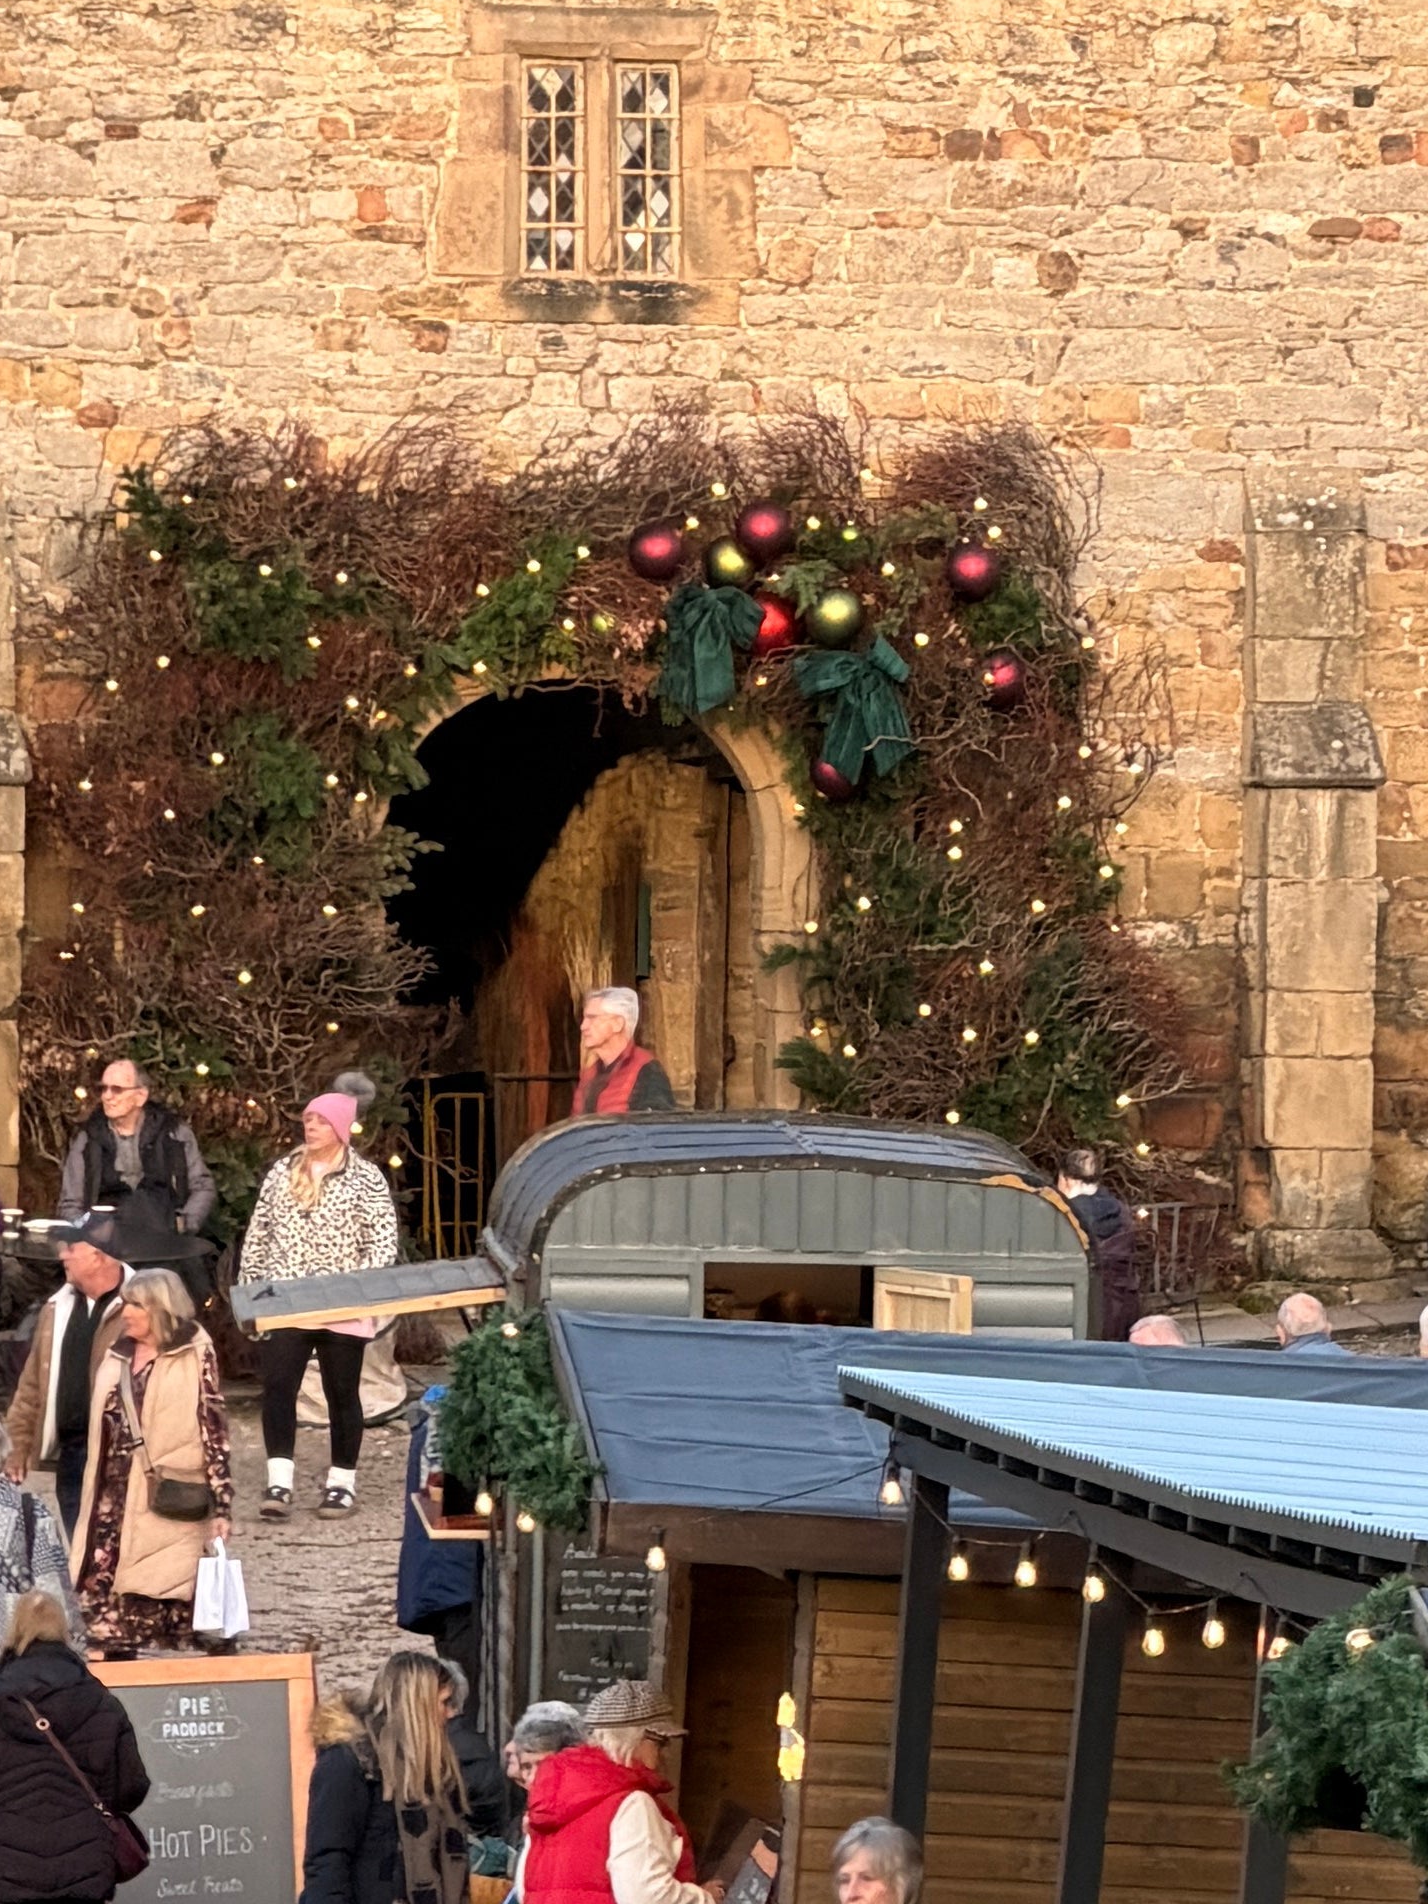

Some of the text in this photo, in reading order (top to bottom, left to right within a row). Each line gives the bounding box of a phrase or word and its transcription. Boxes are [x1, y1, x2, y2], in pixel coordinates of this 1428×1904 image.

[179, 1697, 211, 1716] PIE
[162, 1721, 225, 1738] PADDOCK
[148, 1824, 253, 1860] HOT PIES
